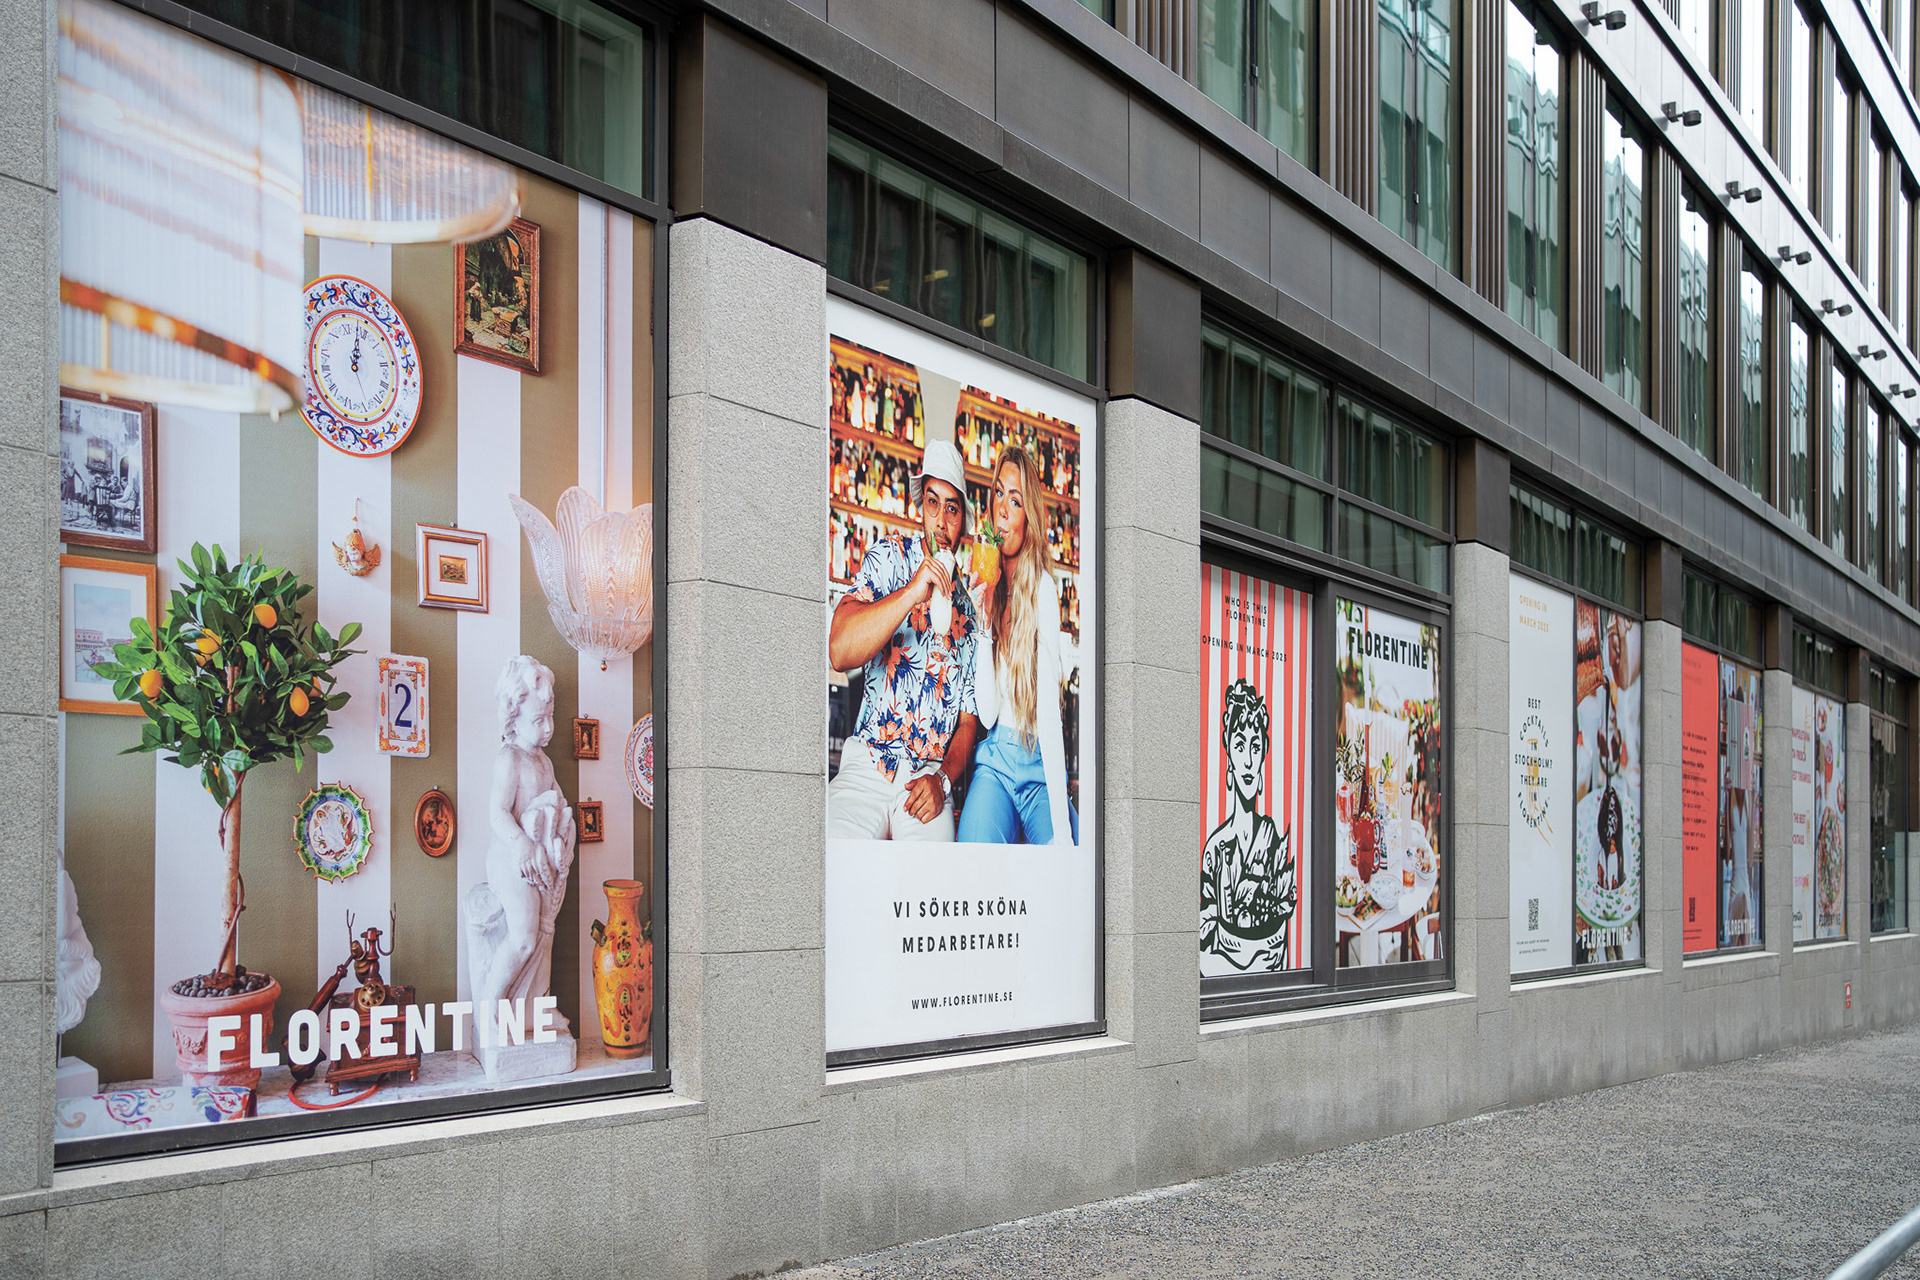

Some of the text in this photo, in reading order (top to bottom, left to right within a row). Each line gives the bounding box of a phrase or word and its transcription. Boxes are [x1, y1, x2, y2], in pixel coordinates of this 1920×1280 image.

[1225, 595, 1267, 615] WHO IS THIS
[1519, 594, 1548, 613] OPENING IN
[1226, 609, 1266, 627] FLORENTINE
[1519, 614, 1536, 629] MARCH
[1202, 635, 1234, 650] OPENING
[1236, 643, 1244, 652] IN
[1246, 645, 1269, 658] MARCH
[1349, 625, 1429, 671] FLORENTINE
[395, 683, 412, 728] 2
[1527, 697, 1541, 710] BEST
[1519, 715, 1549, 748] COCKTAILS
[1520, 774, 1548, 788] THEY ARE
[893, 896, 1027, 918] VI SÖKER SKÖNA
[902, 933, 1019, 954] MEDARBETARE!
[1581, 926, 1630, 950] FLORENTINE
[911, 991, 1013, 1010] WWW.FLORENTINE.SE
[207, 995, 559, 1073] FLORENTINE
